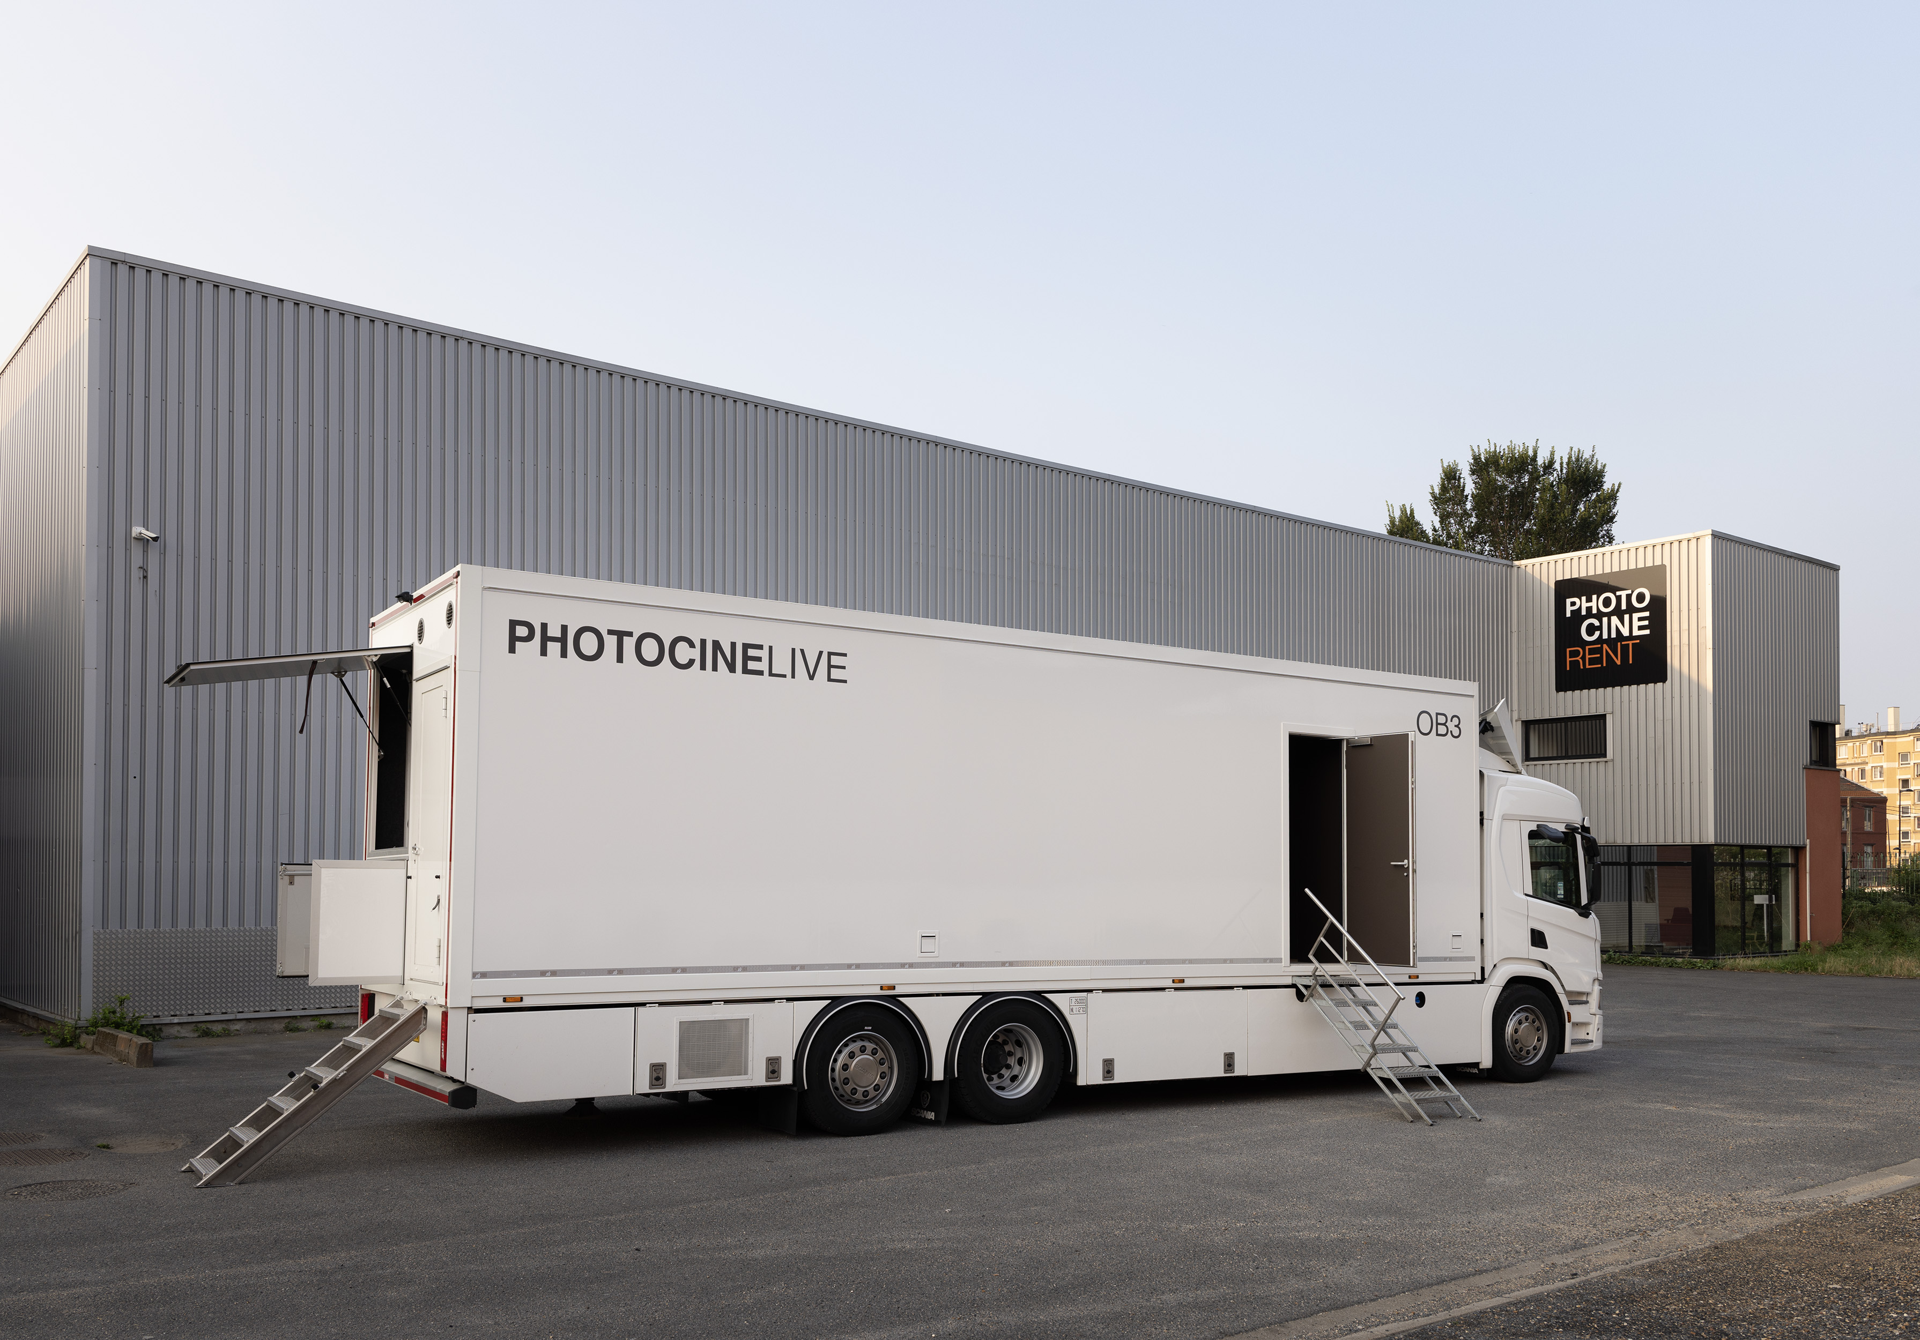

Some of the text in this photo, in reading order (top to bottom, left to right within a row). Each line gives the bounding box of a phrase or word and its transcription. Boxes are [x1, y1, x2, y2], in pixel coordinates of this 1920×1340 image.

[1565, 587, 1650, 617] PHOTO
[1580, 611, 1650, 642] CINE
[508, 619, 847, 684] PHOTOCINELIVE
[1566, 639, 1640, 670] RENT
[1417, 710, 1462, 739] OB3
[911, 1108, 935, 1120] SCANIA
